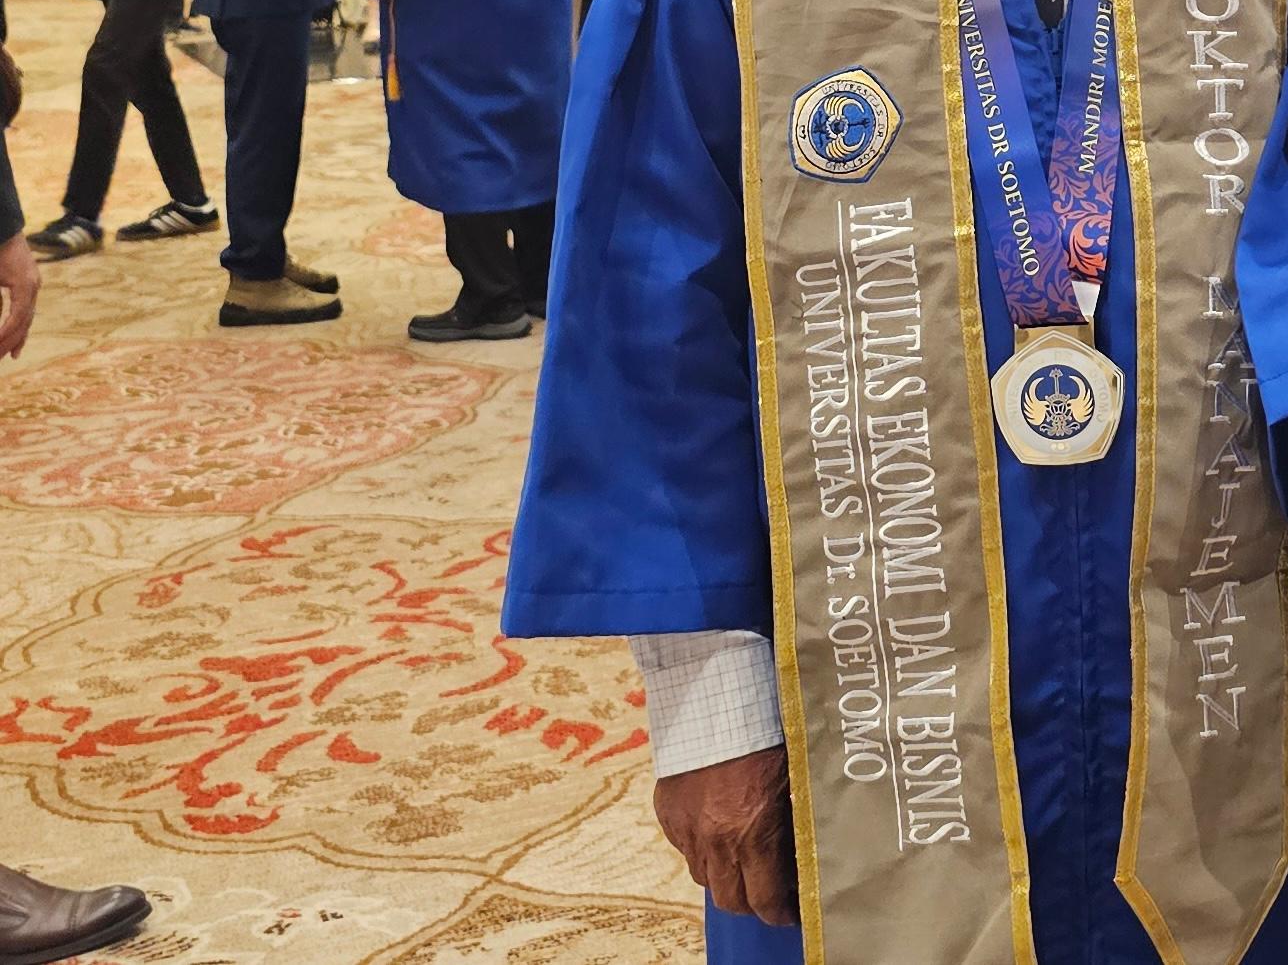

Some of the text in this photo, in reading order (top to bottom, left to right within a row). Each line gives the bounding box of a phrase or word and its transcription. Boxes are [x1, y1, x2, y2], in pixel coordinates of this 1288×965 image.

[987, 123, 1010, 158] DR
[1078, 73, 1106, 174] MANDIRI
[997, 161, 1040, 277] SOETOMO
[795, 259, 864, 519] UNIVERSITAS
[849, 197, 971, 844] FAKULTAS EKONOMI DAN BISNIS
[828, 595, 888, 782] SOETOMO
